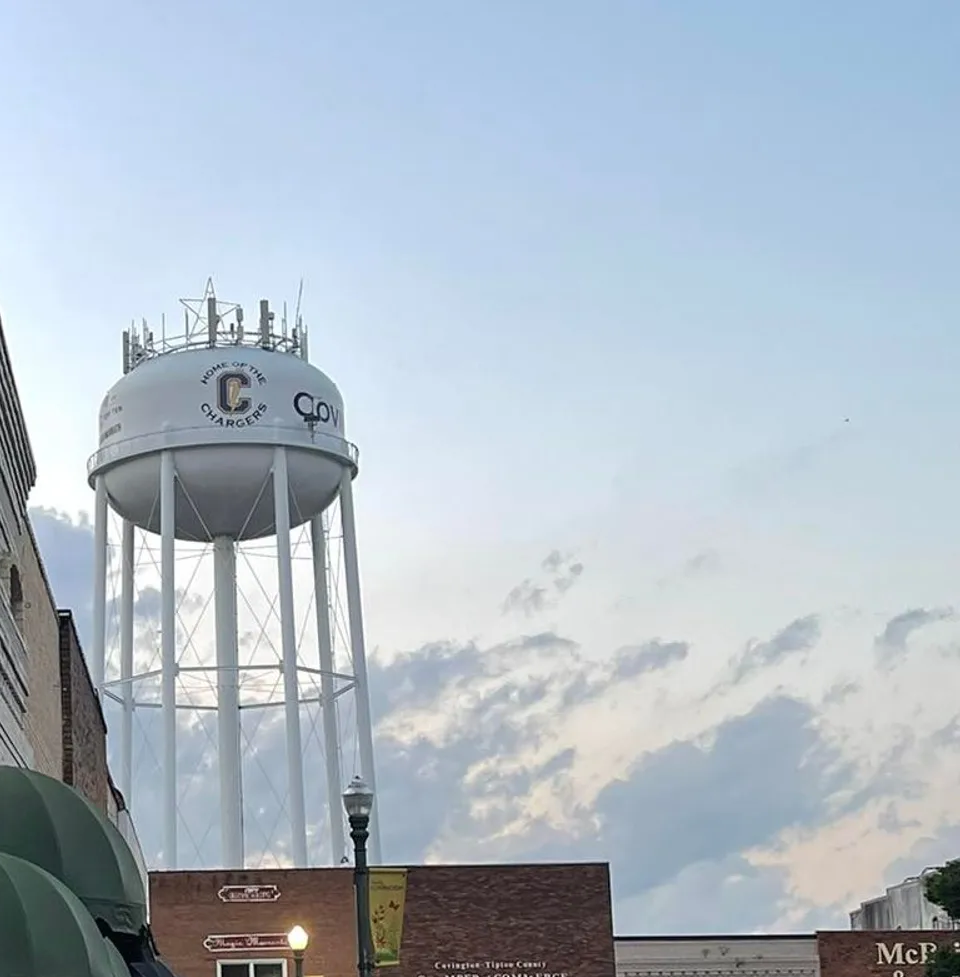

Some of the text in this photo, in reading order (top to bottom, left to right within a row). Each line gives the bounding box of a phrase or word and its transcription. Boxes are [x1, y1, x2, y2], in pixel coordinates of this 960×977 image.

[200, 362, 229, 385] HOME
[249, 362, 268, 386] THE
[200, 402, 268, 429] CHARGERS
[516, 961, 547, 969] County
